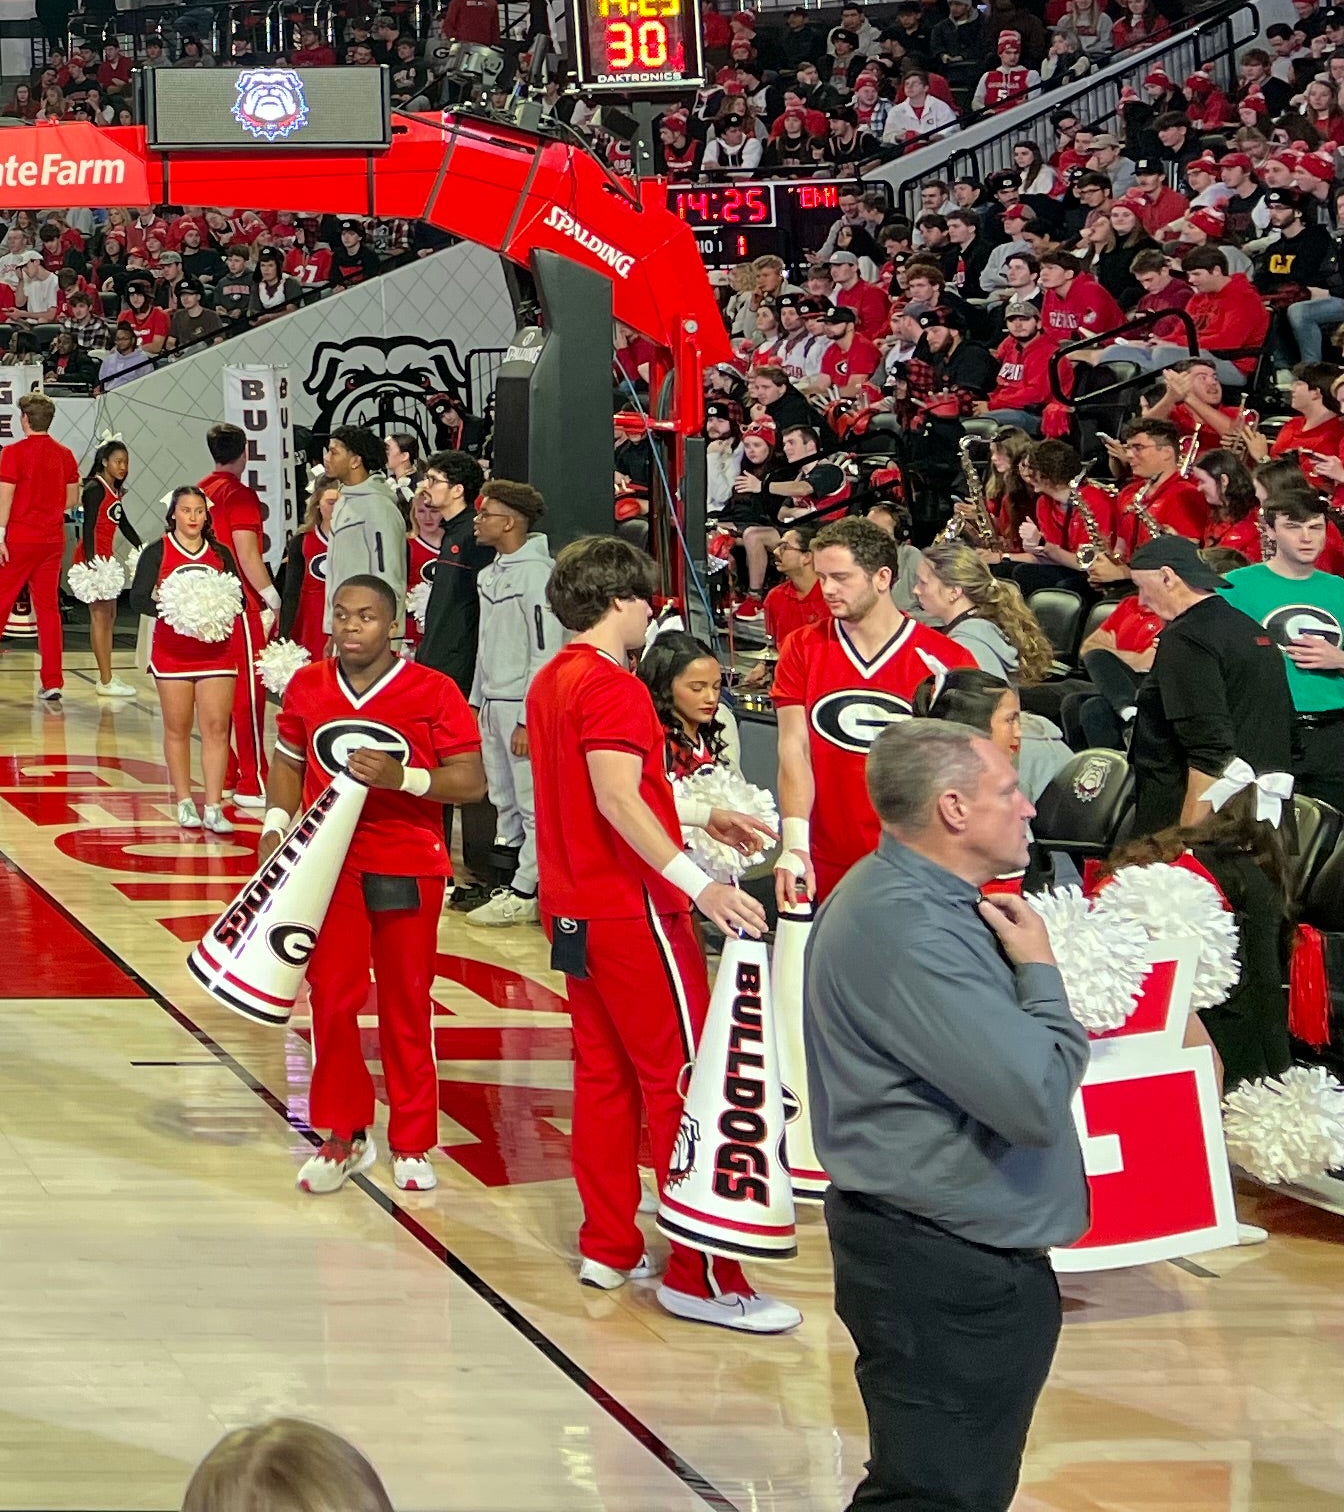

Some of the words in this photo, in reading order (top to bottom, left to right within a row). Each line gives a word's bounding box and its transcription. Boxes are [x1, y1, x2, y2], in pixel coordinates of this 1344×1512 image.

[607, 20, 669, 70] 30
[597, 72, 683, 84] DAKTRONICS
[676, 187, 767, 223] 14:25
[543, 205, 636, 279] SPALDING
[711, 960, 771, 1208] BULLDOGS
